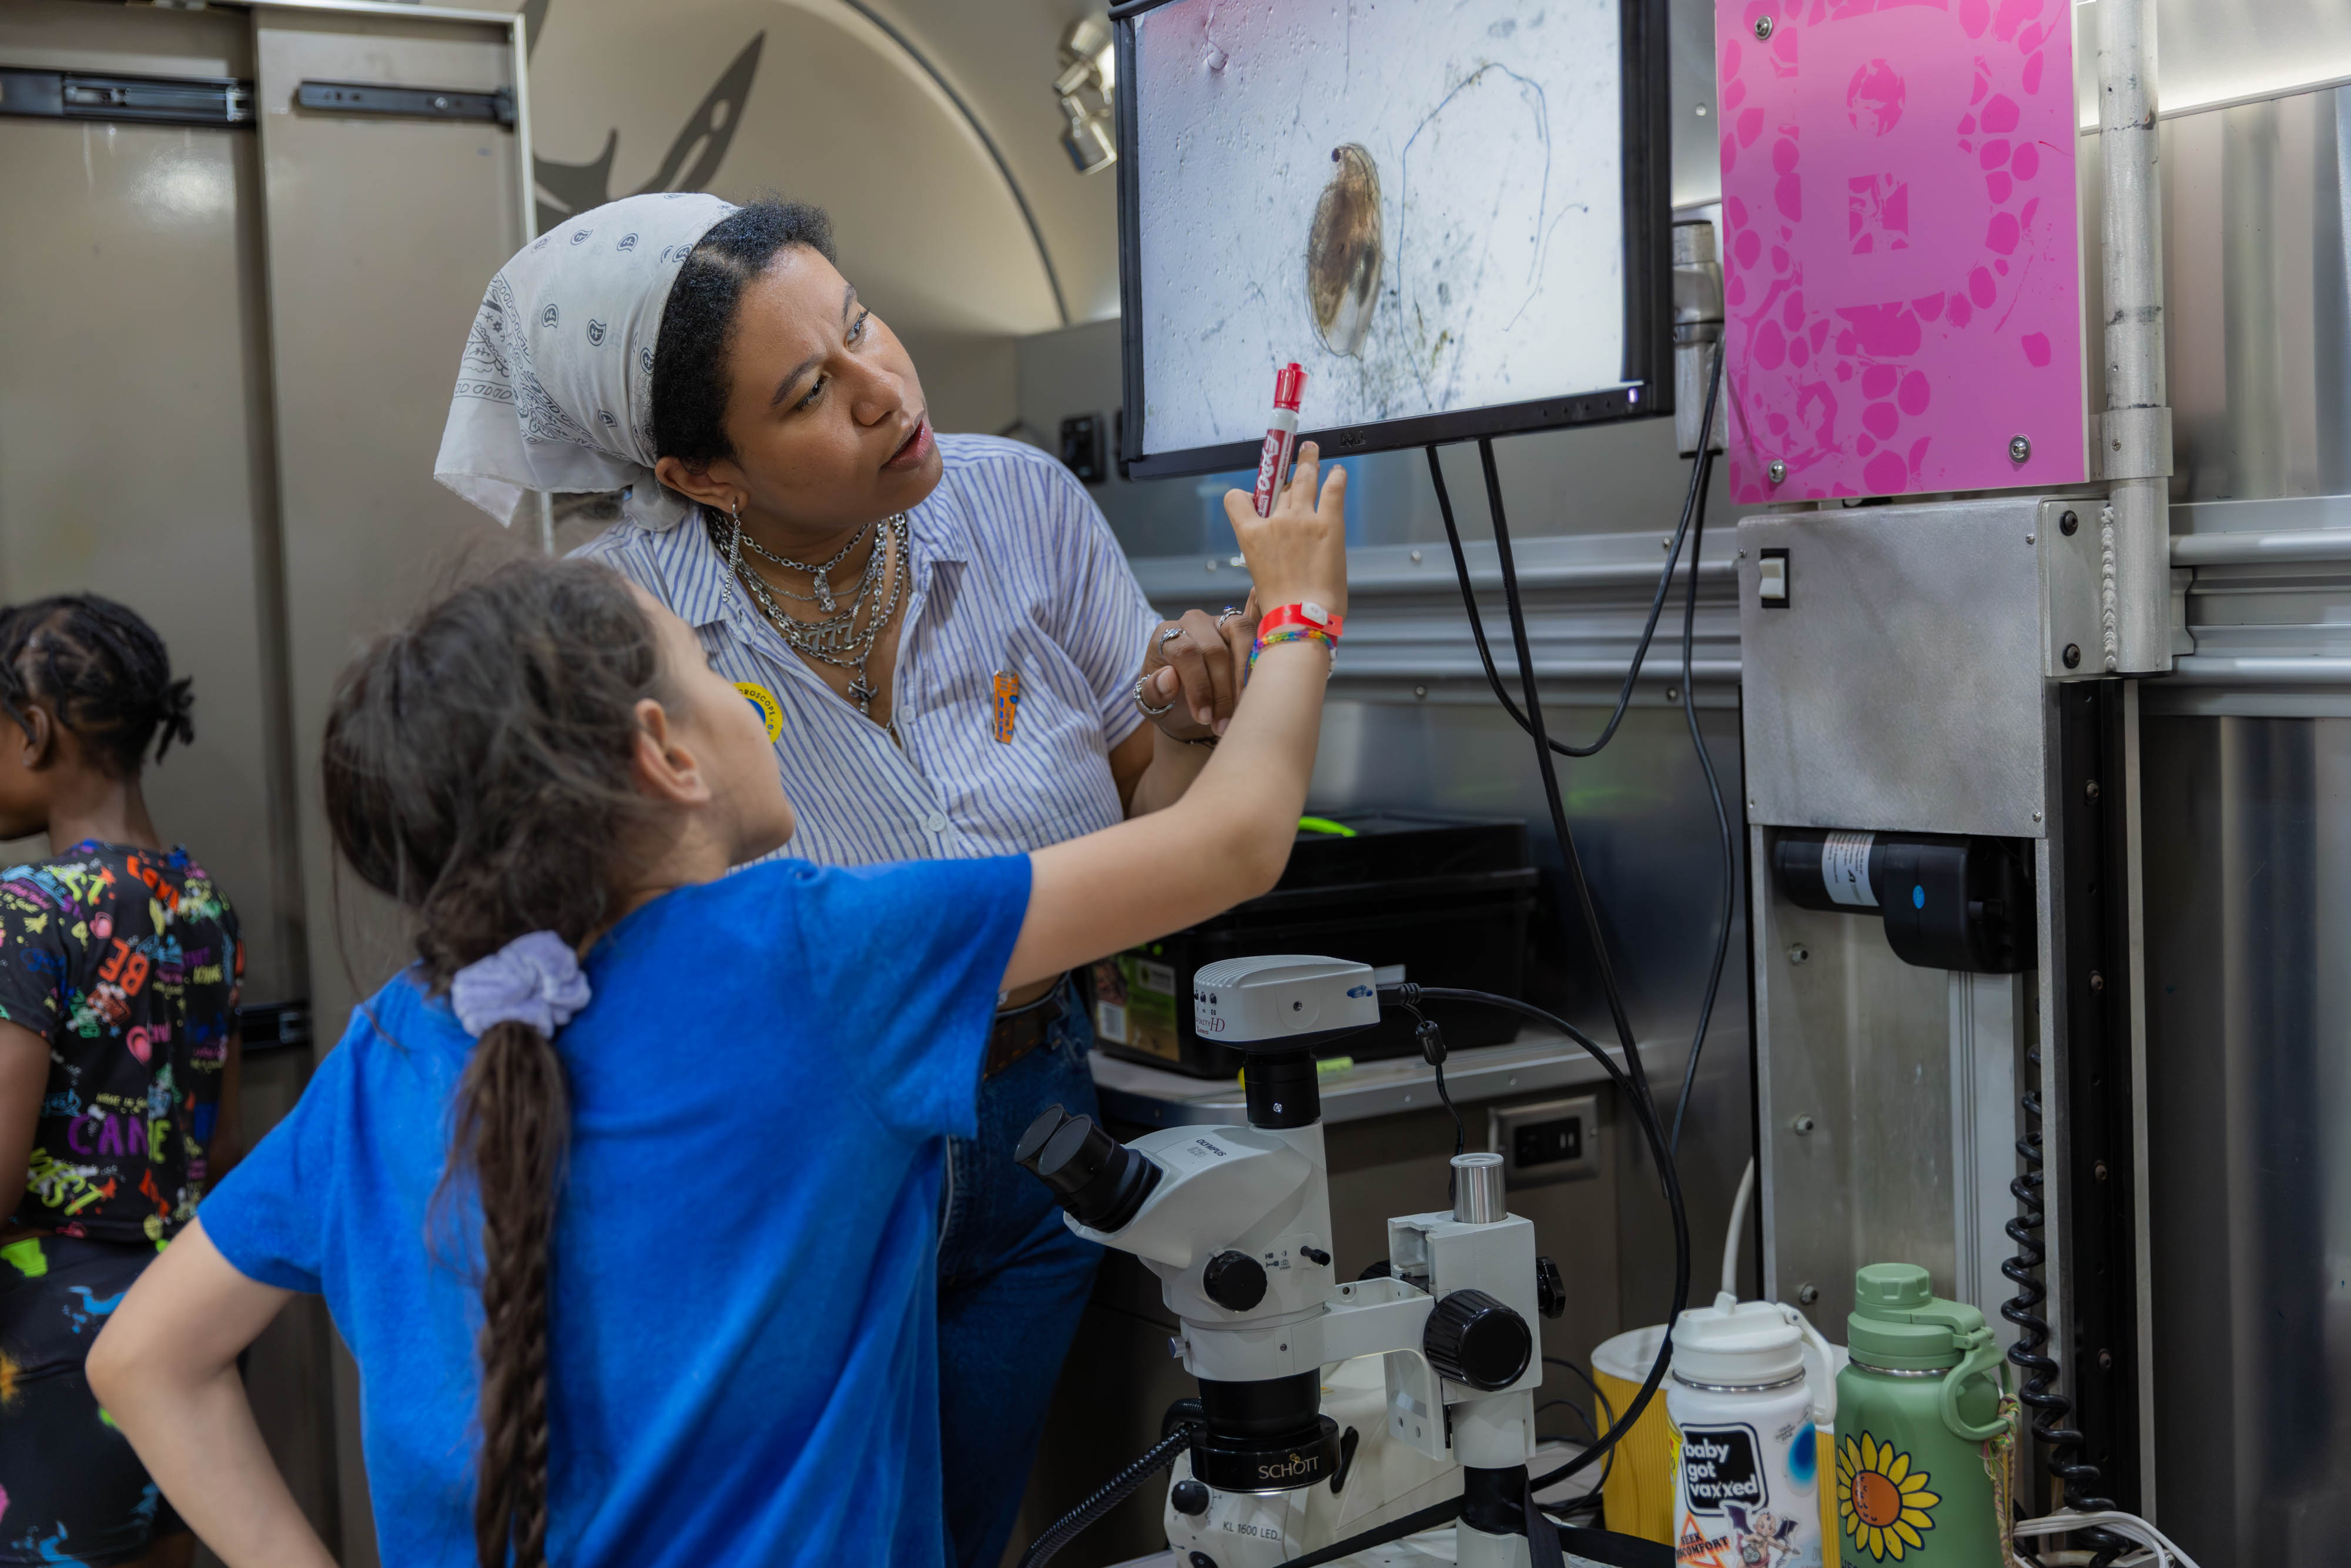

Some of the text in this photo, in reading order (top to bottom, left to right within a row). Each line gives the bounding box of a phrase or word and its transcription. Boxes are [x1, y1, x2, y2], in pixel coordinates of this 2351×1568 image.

[1257, 434, 1280, 491] EXPO
[1196, 1139, 1227, 1157] OLYMPUS
[1684, 1438, 1730, 1463] baby
[1258, 1456, 1319, 1480] SCHOTT
[1687, 1460, 1717, 1482] got
[1689, 1473, 1759, 1499] vaxxed
[1223, 1521, 1278, 1540] KL 1600 LED
